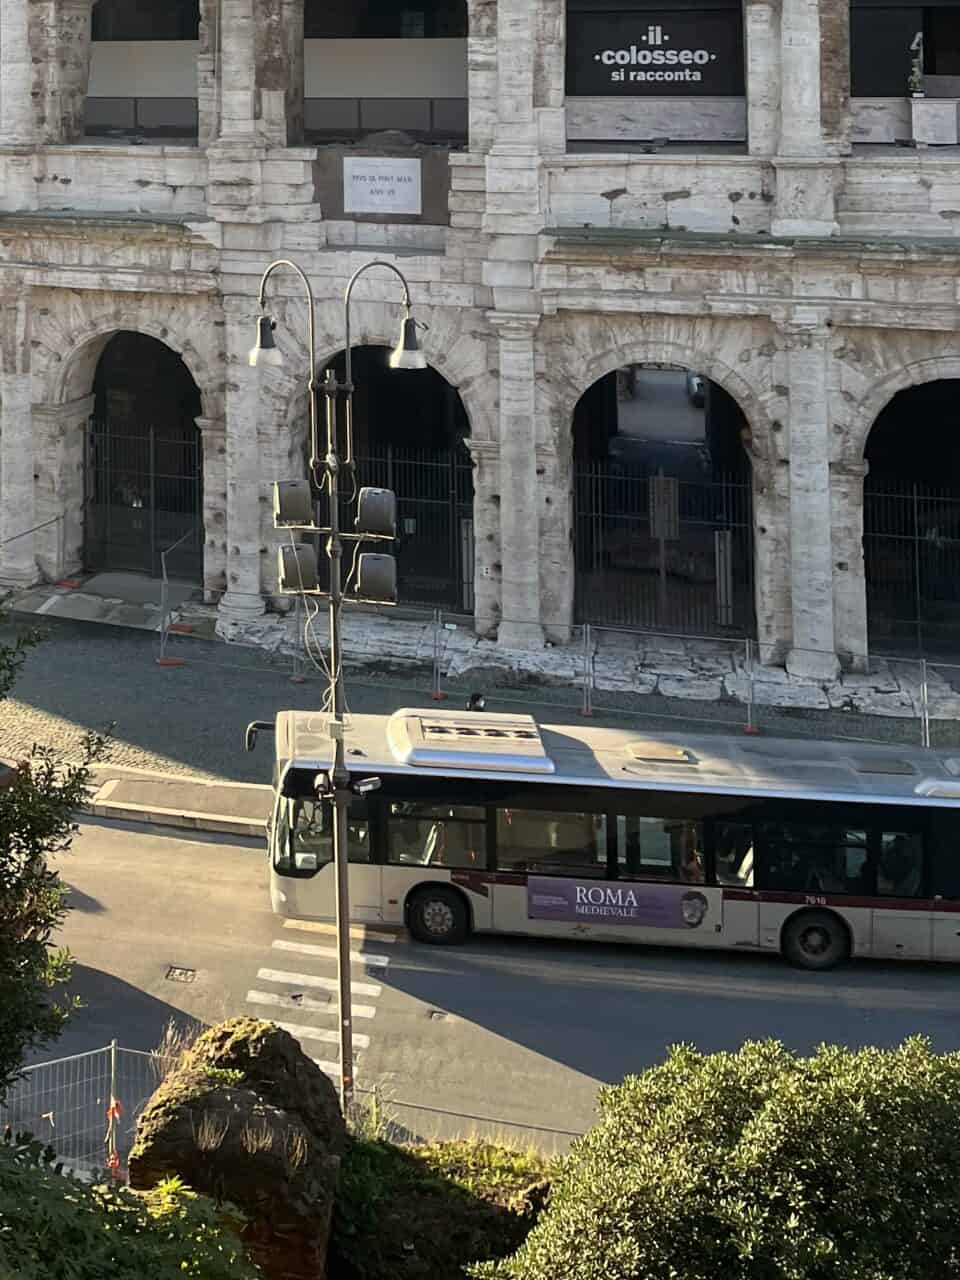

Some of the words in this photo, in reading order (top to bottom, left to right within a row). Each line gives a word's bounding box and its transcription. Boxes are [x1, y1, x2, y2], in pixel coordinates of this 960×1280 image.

[601, 45, 709, 65] colosseo
[611, 69, 625, 81] si
[629, 69, 702, 81] racconta
[575, 886, 638, 907] ROMA
[575, 904, 637, 918] MEDIEVALE
